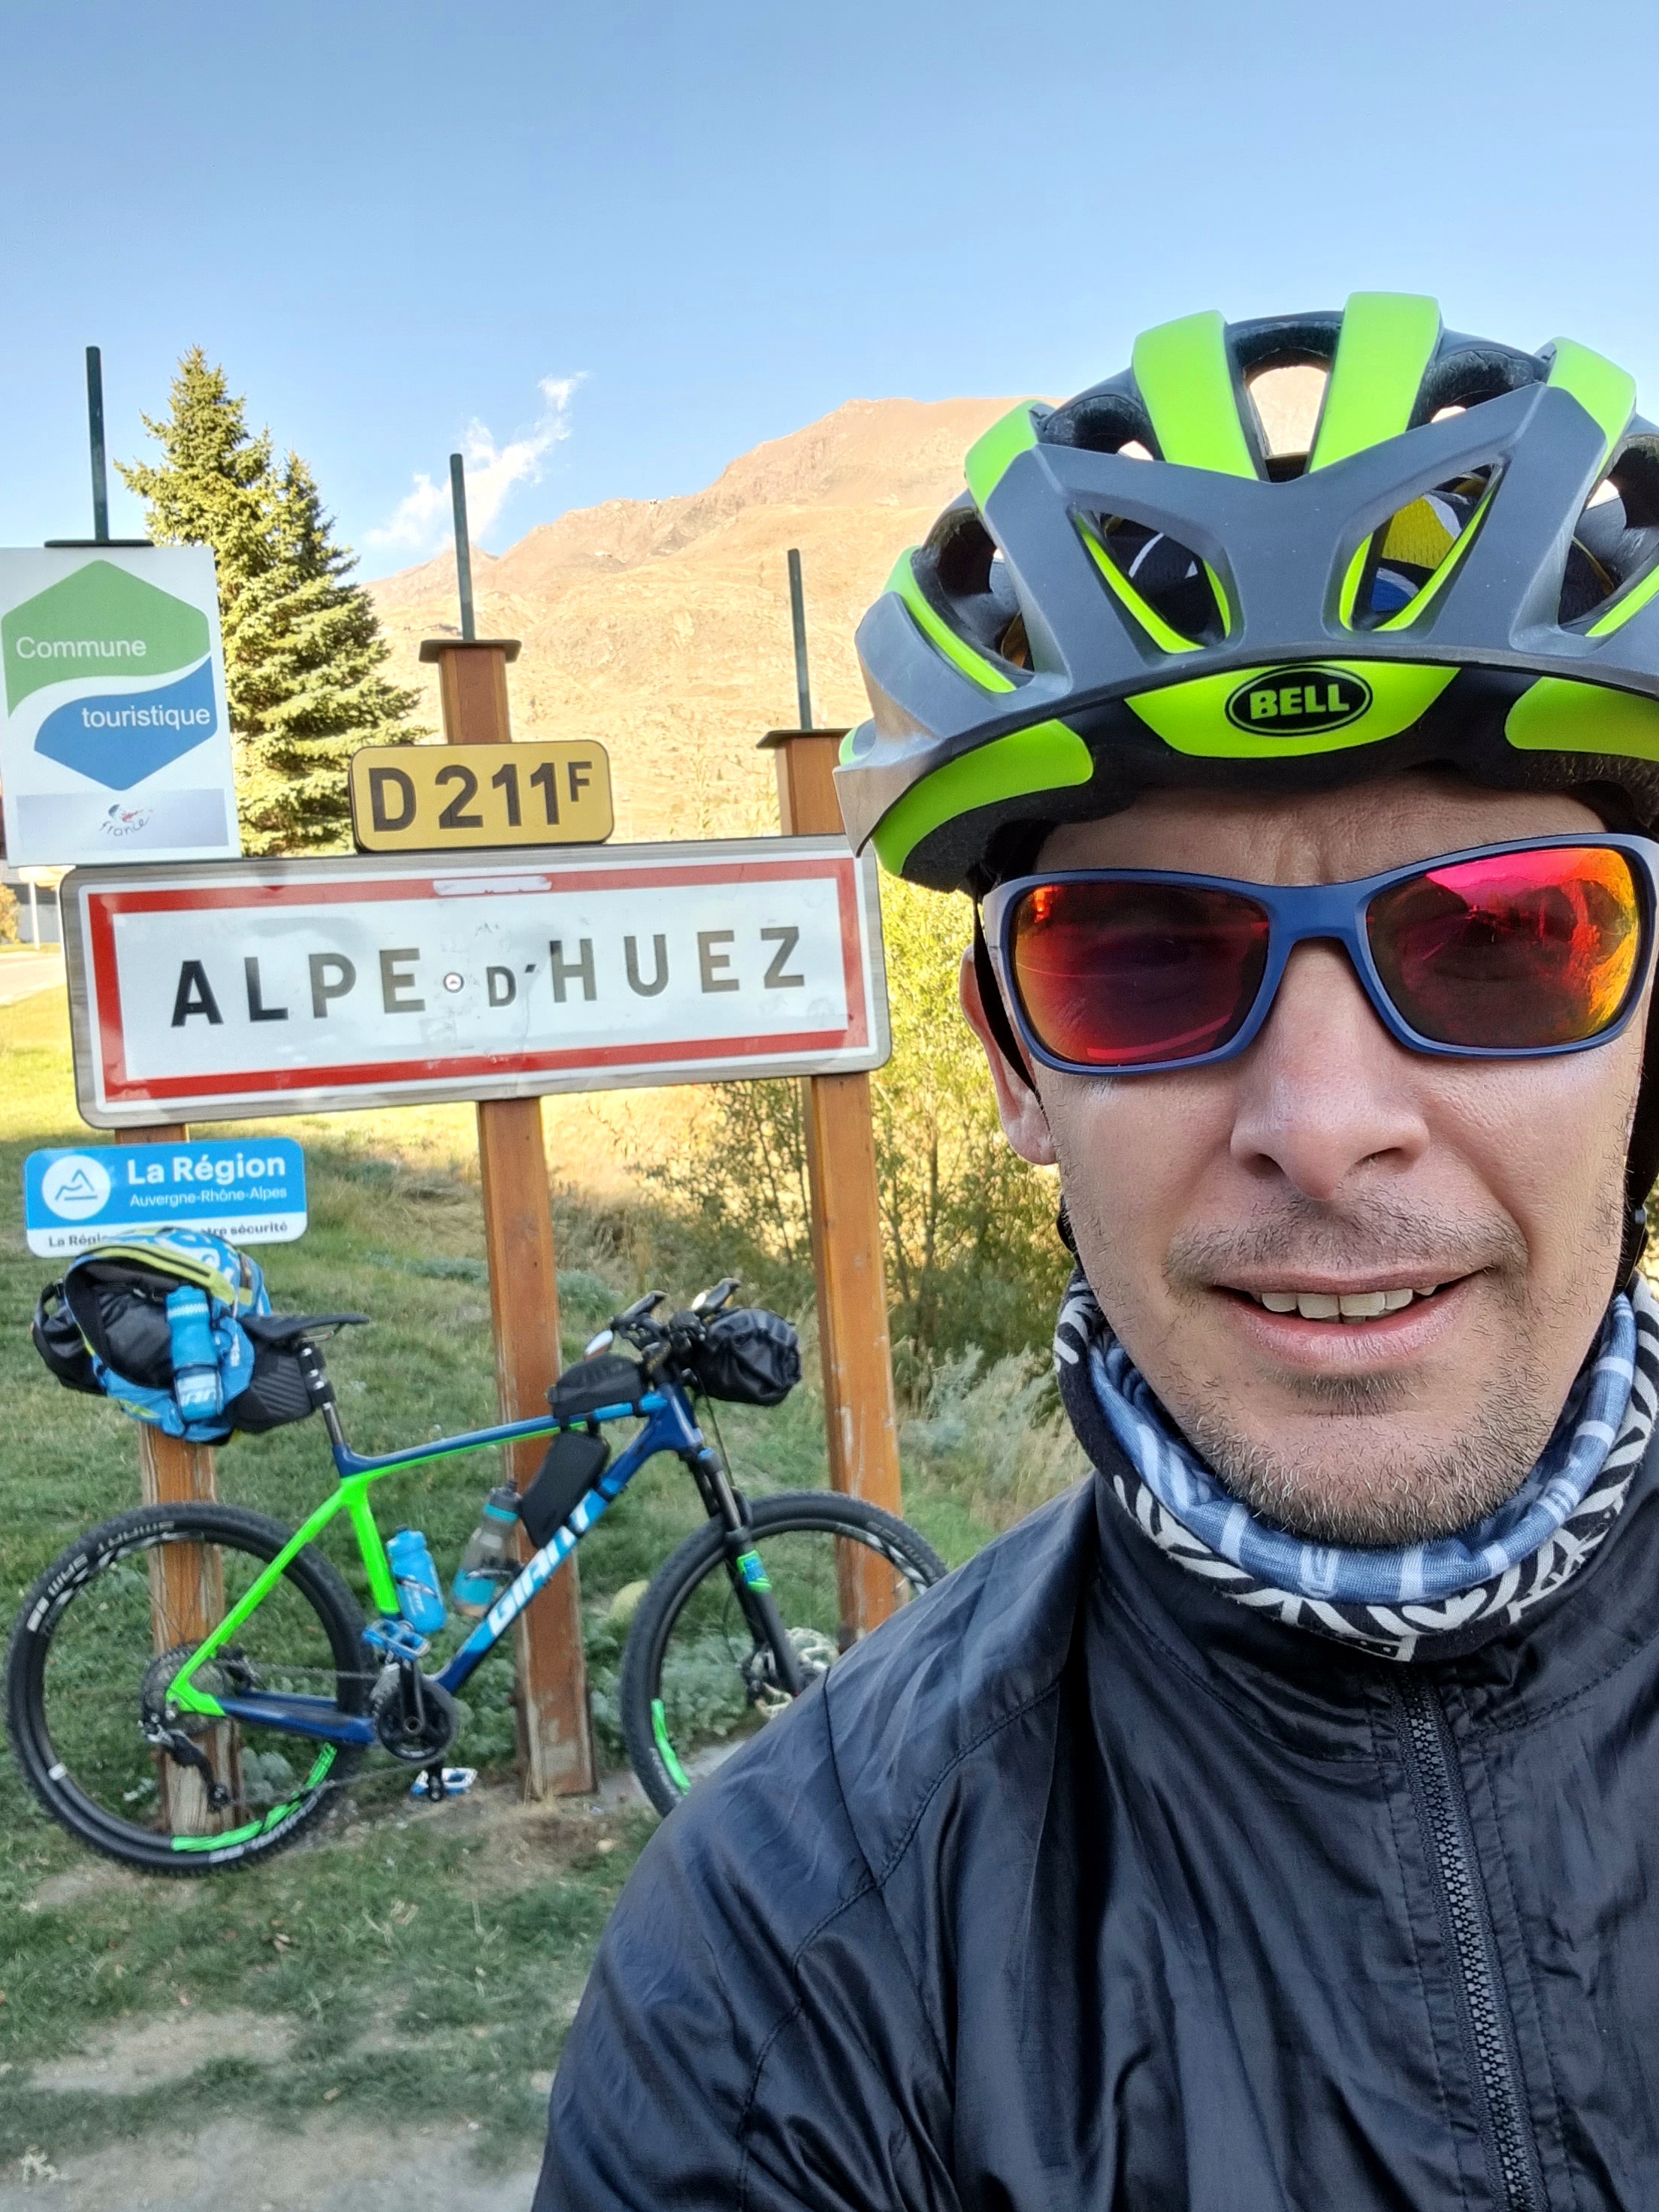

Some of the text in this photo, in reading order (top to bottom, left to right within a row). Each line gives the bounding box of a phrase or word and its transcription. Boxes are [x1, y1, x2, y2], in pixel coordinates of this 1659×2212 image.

[16, 636, 147, 659] Commune
[1250, 683, 1350, 720] BELL
[81, 706, 211, 730] touristique
[171, 947, 426, 1028] ALPE
[127, 1153, 286, 1186] La Région
[129, 1186, 288, 1208] Auvergne-Rhône-Alpes
[48, 1236, 66, 1247] La
[230, 1220, 289, 1235] sécurité
